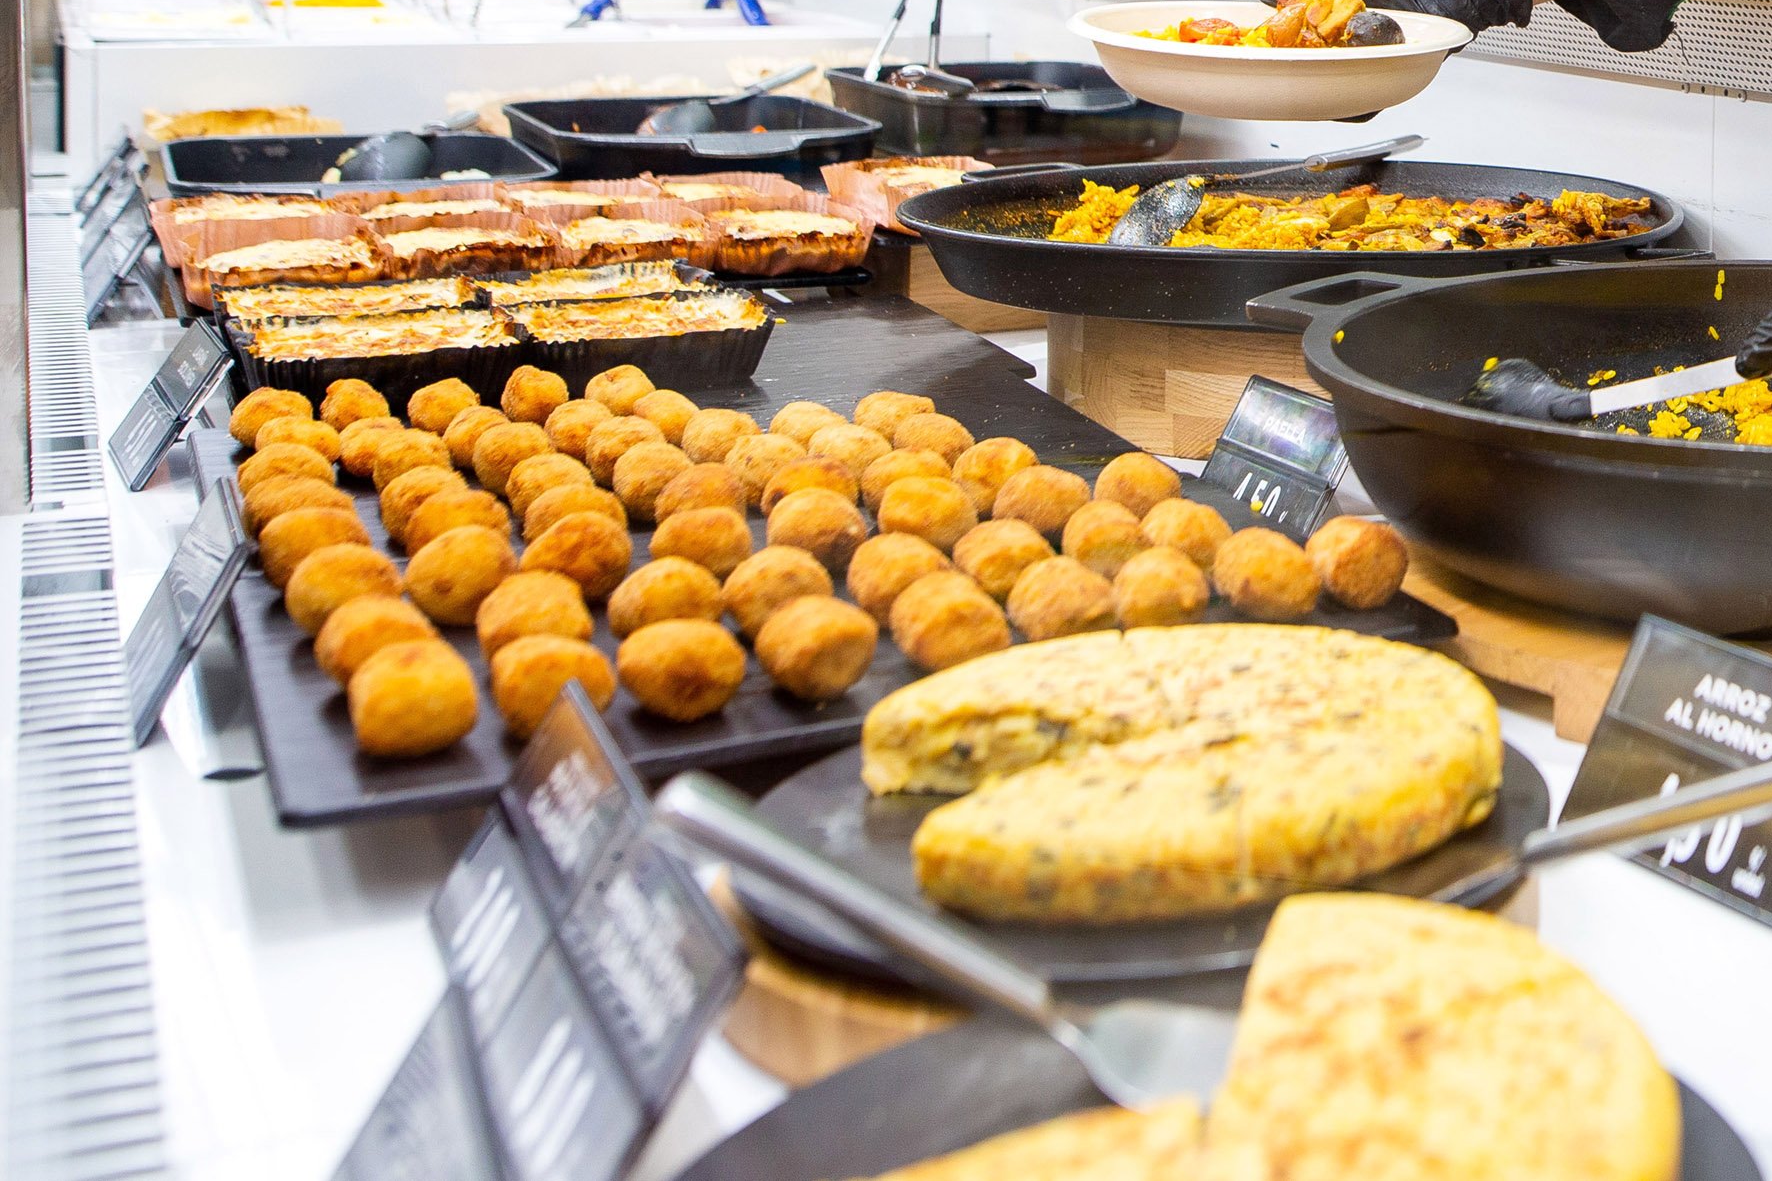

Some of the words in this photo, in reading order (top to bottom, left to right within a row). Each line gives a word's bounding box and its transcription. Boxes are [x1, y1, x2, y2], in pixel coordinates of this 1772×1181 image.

[1262, 417, 1307, 444] PAELLA
[1664, 697, 1695, 731] AL
[1693, 673, 1772, 725] ARROZ
